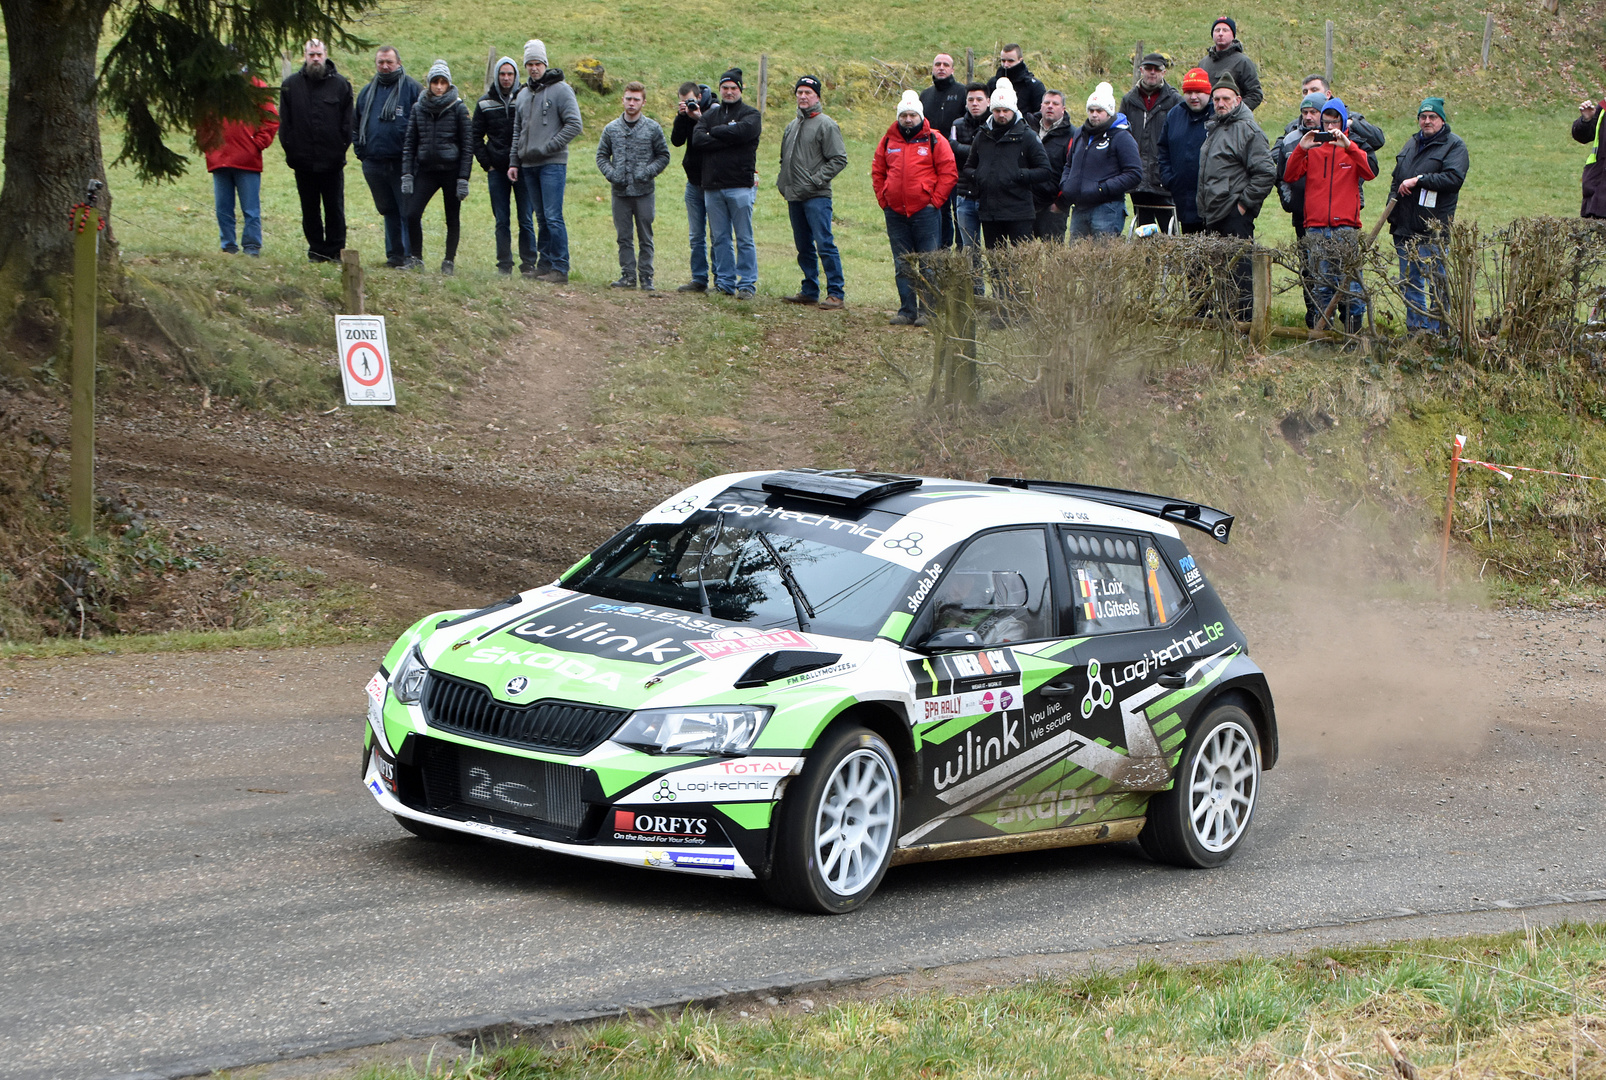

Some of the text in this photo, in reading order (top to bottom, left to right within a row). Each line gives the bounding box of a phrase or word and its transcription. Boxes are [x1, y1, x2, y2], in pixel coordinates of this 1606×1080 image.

[345, 329, 378, 340] ZONE
[700, 500, 886, 540] Logi-technic
[1179, 555, 1195, 573] PRO
[1184, 567, 1200, 583] LEASE
[907, 563, 943, 612] skoda.be
[1090, 578, 1125, 596] F. Loix
[1148, 570, 1166, 623] 1
[514, 622, 681, 662] wilink
[698, 639, 737, 654] SPA
[744, 631, 796, 648] RALLY
[952, 650, 1012, 677] HEROCK
[1111, 621, 1224, 687] Logi-technic.be
[464, 646, 621, 692] ŠKODA
[922, 658, 938, 696] 1
[368, 678, 385, 702] TOTAL
[787, 677, 799, 685] FM
[925, 696, 961, 719] SPA RALLY
[1030, 702, 1062, 725] You live.
[1030, 712, 1072, 740] We secure
[934, 711, 1020, 790] wilink
[720, 762, 790, 774] TOTAL
[676, 780, 769, 792] Logi-technic
[635, 814, 708, 835] ORFYS
[613, 832, 625, 840] On
[637, 834, 656, 842] Road
[656, 835, 667, 843] For
[683, 837, 706, 845] Safety
[676, 856, 735, 866] MICHELIN
